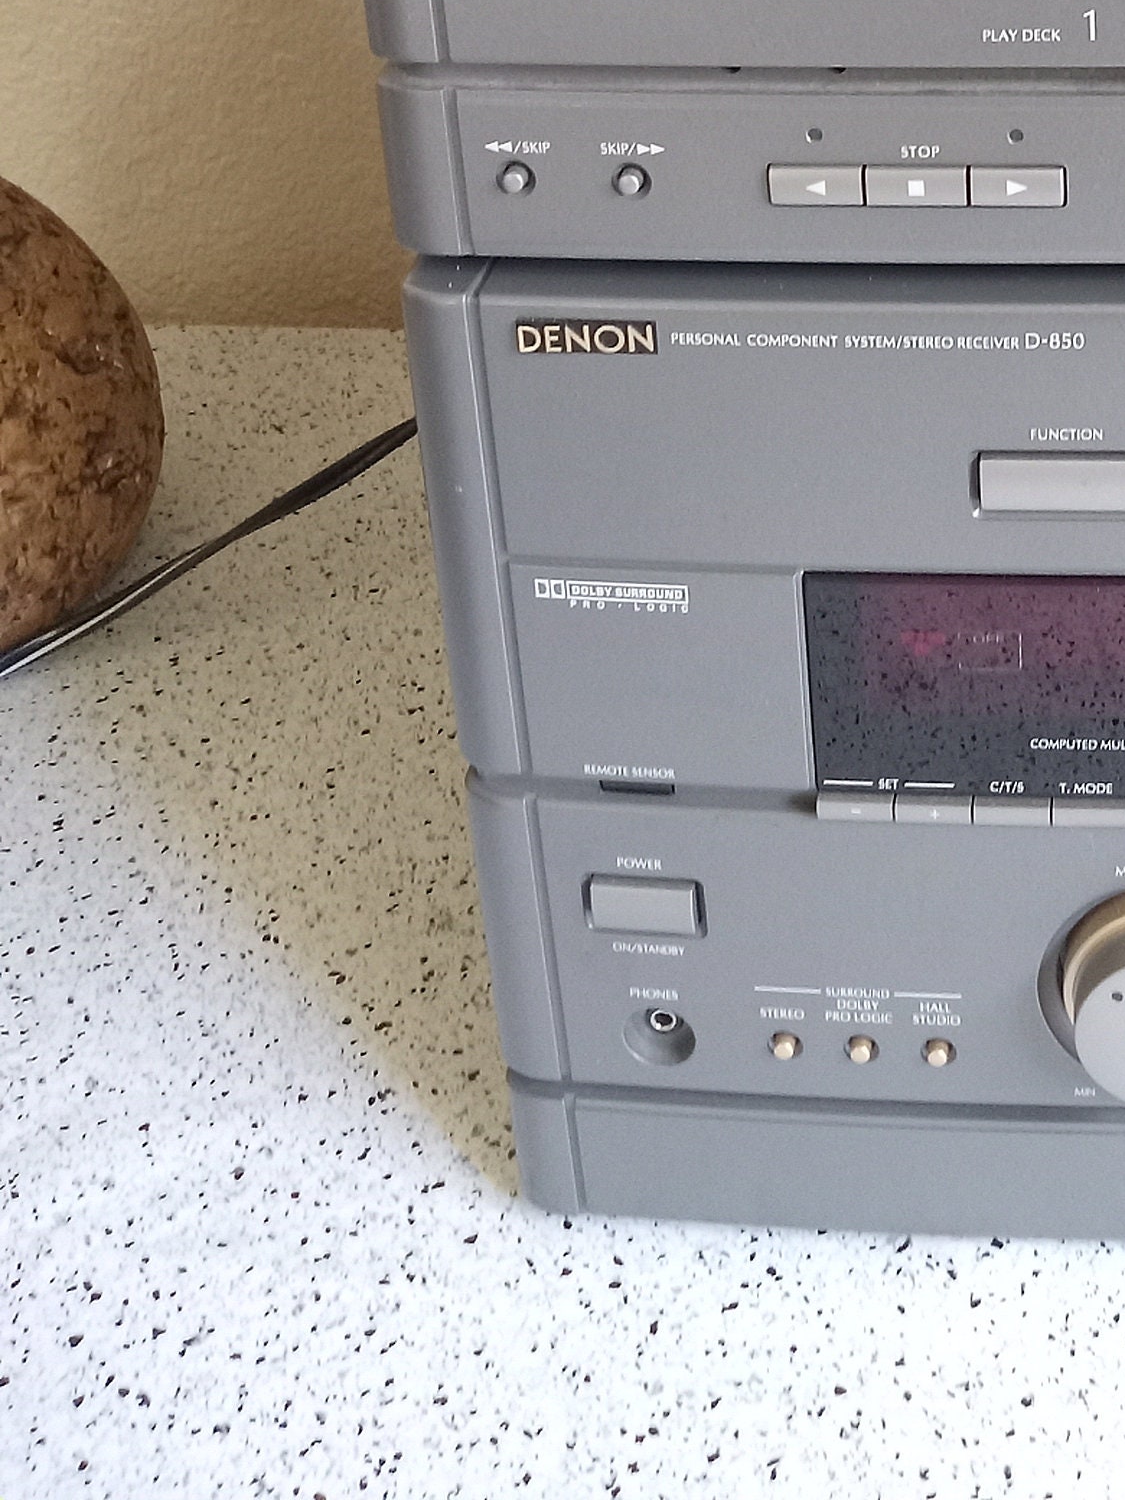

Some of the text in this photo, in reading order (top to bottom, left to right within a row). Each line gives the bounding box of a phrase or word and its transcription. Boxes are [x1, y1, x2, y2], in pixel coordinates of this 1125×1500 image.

[1082, 8, 1098, 42] 1
[982, 27, 1062, 44] PLAY DECK
[900, 144, 941, 159] STOP
[517, 324, 655, 354] DENON
[670, 331, 1085, 351] PERSONAL COMPONENT SYSTEM/STEREO RECEIVER D-850
[1030, 428, 1104, 441] FUNCTION
[571, 584, 683, 600] DOLBY SURROUND
[1030, 738, 1097, 751] COMPUTED
[584, 763, 675, 780] REMOTE SENSOR
[878, 779, 899, 791] SET
[1074, 782, 1113, 795] MODE
[616, 856, 662, 870] POWER
[613, 942, 685, 956] ON/STANDBY
[629, 987, 679, 1001] PHONES
[825, 987, 890, 999] SURROUND
[836, 999, 879, 1011] DOLBY
[920, 1002, 951, 1013] HALL
[759, 1007, 805, 1020] STEREO
[825, 1011, 893, 1024] PRO LOGIC
[912, 1014, 962, 1027] STUDIO
